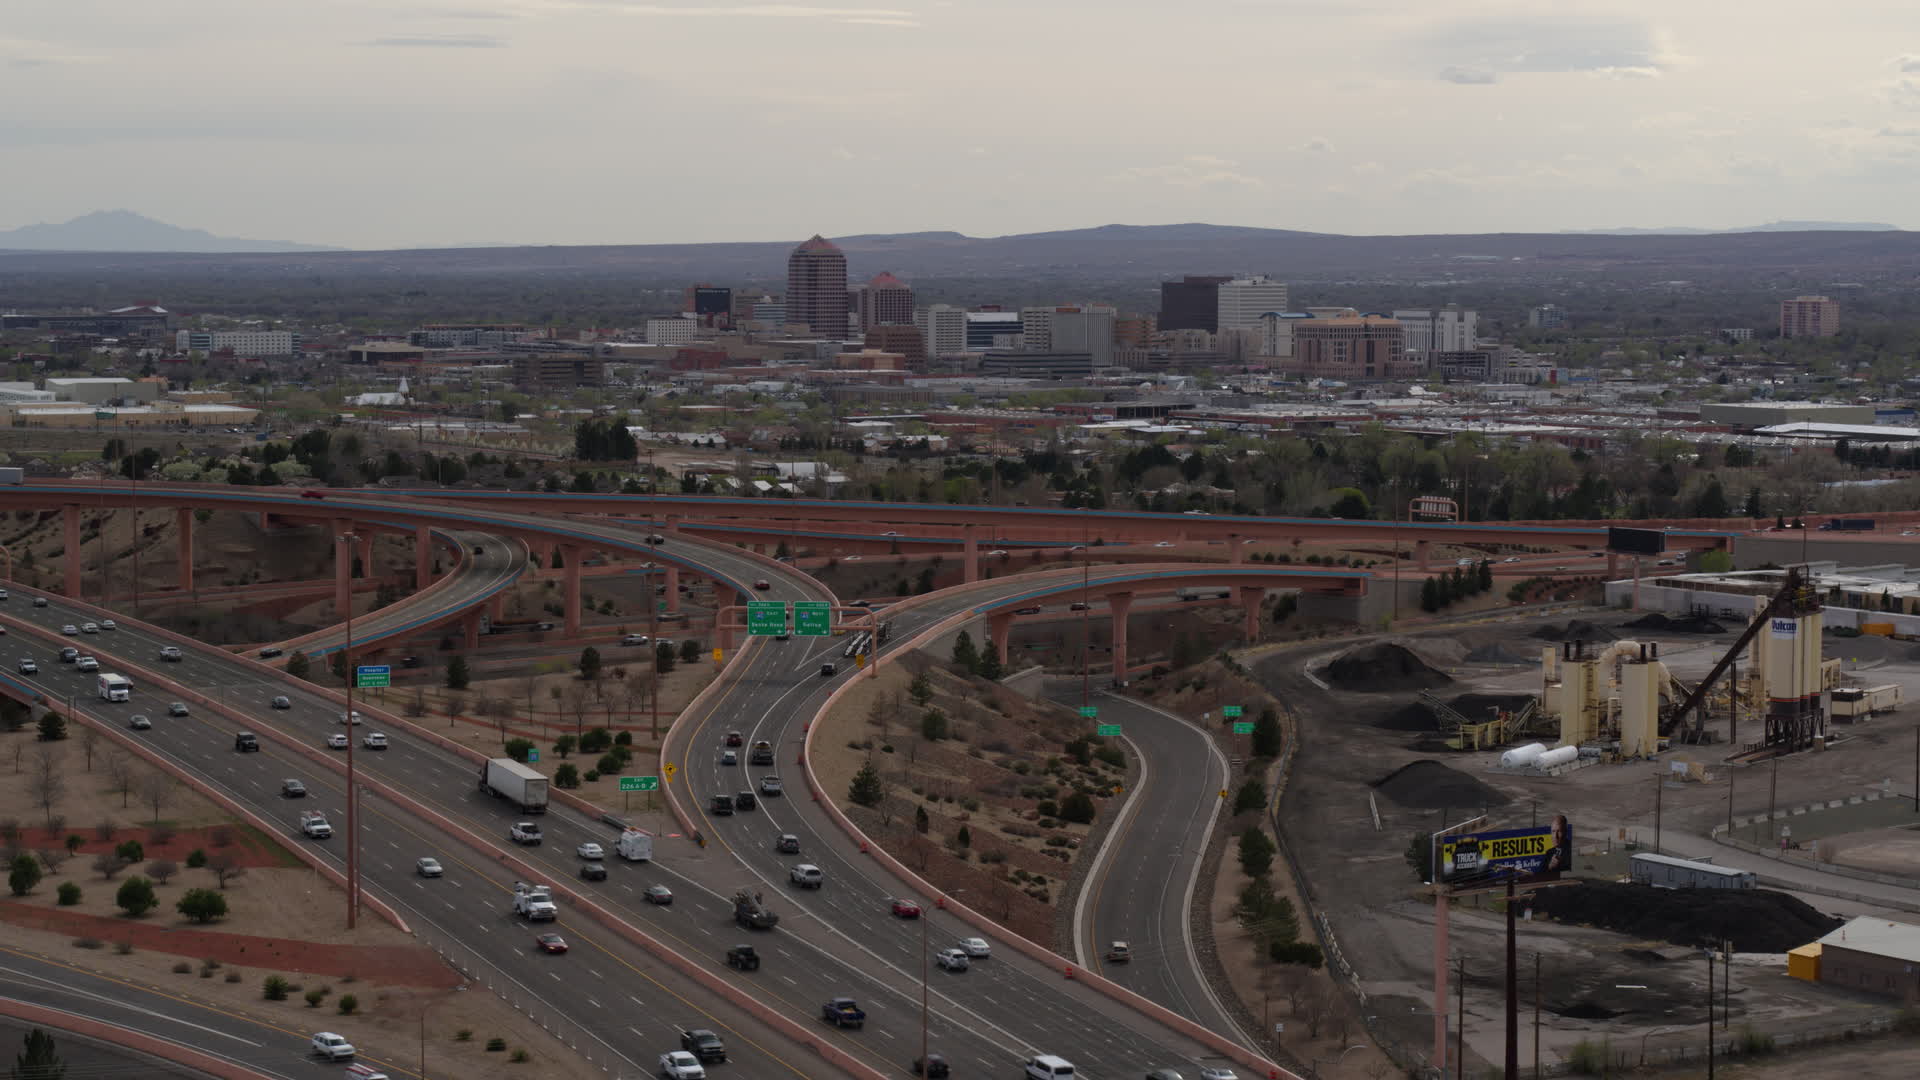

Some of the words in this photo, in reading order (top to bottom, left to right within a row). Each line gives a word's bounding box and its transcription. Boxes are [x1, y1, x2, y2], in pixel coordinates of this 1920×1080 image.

[1772, 619, 1797, 631] Vulcan
[1492, 837, 1545, 858] RESULTS
[1456, 851, 1477, 863] TRUCK
